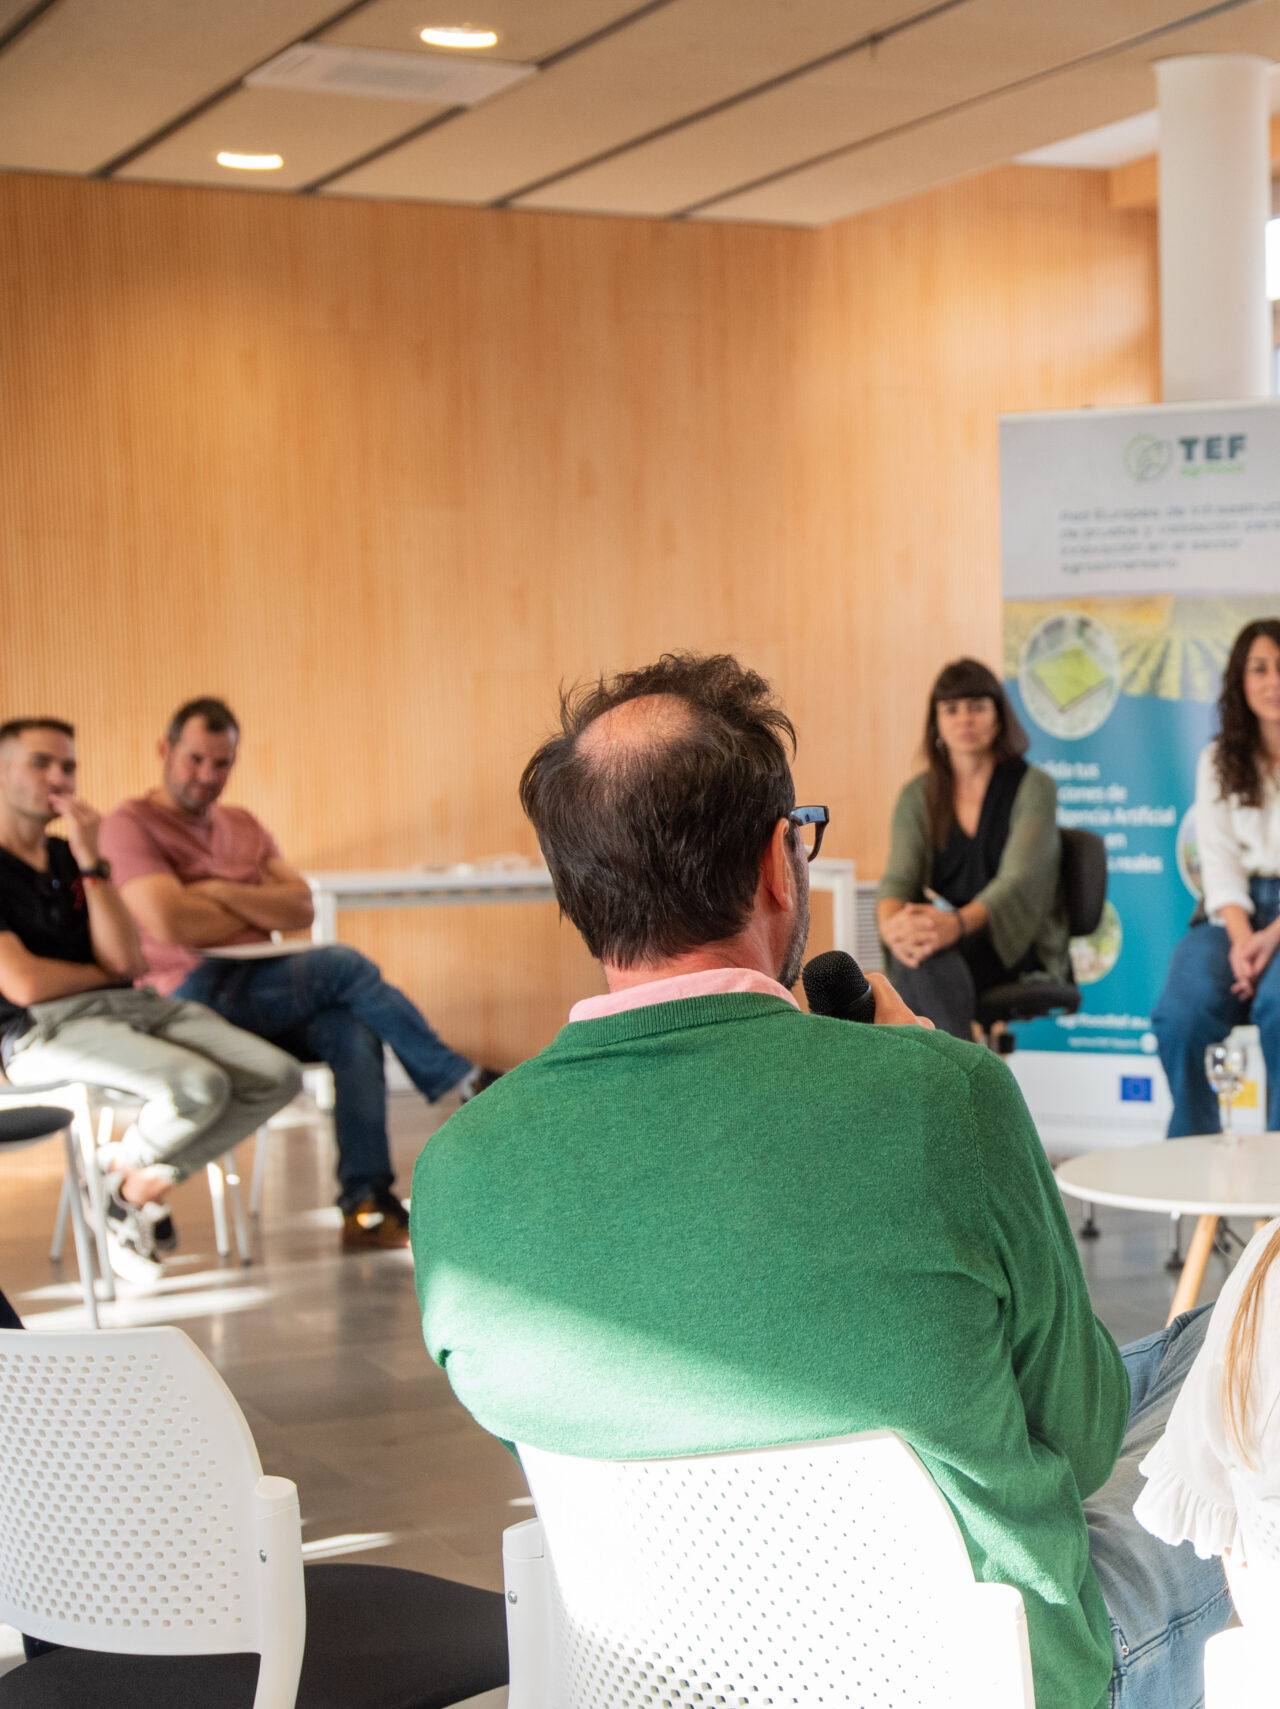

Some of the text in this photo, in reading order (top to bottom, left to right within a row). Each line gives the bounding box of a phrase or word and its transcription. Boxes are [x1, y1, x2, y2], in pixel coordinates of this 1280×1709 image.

[1178, 433, 1246, 463] TEF
[1106, 782, 1128, 803] de
[1114, 804, 1177, 827] Artificial
